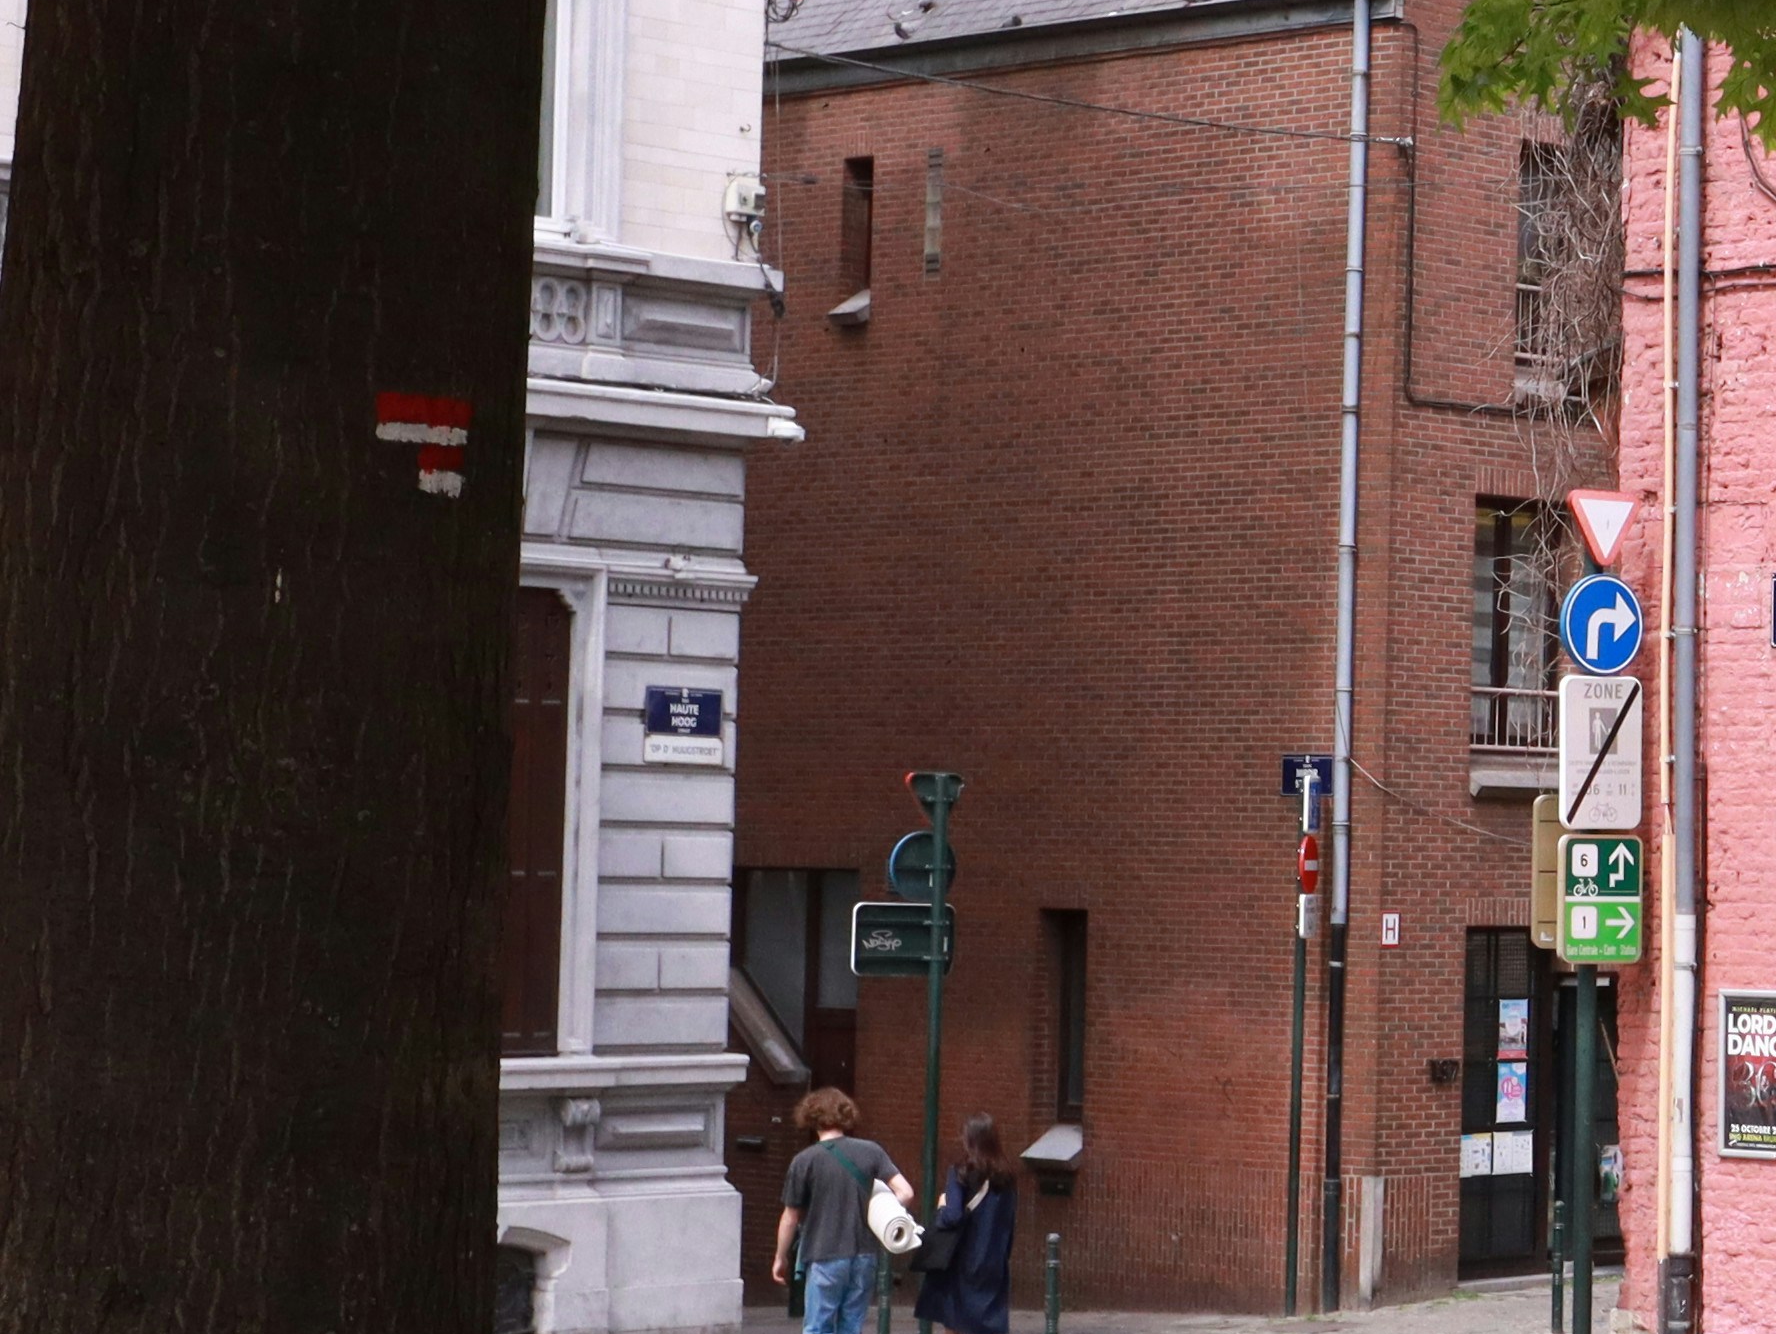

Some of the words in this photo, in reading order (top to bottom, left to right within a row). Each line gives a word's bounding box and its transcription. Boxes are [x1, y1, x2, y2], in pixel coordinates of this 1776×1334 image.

[1584, 683, 1623, 699] ZONE
[669, 703, 700, 716] HAUTE
[671, 716, 697, 728] HOOG
[1580, 853, 1588, 866] 6
[1385, 918, 1396, 940] H
[1728, 1013, 1776, 1034] LORD
[1741, 1124, 1771, 1134] OCTOBRE
